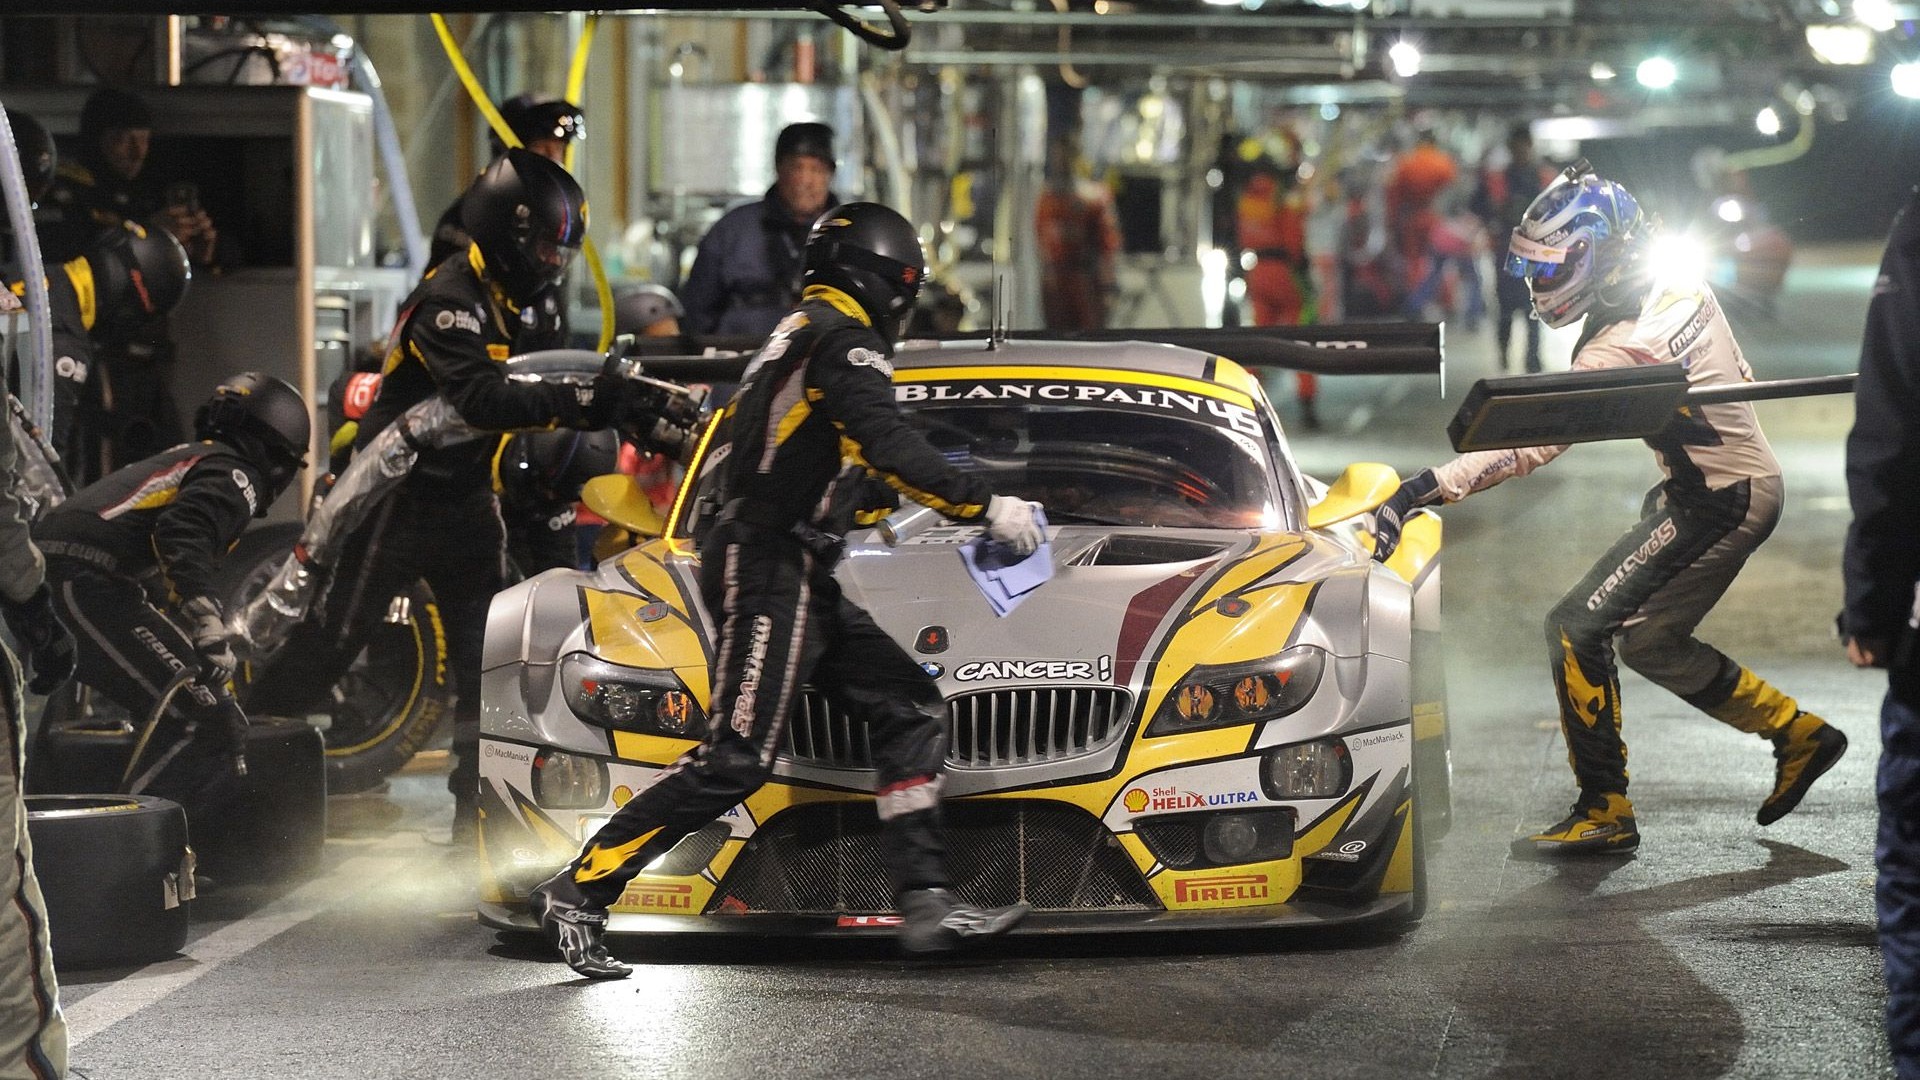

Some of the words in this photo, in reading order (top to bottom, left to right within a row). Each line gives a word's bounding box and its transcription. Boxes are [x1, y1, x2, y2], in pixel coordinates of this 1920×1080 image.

[892, 384, 1203, 414] BLANCPAIN
[1205, 399, 1264, 438] 45
[1152, 786, 1176, 797] Shell
[1152, 794, 1208, 811] HELIX
[1208, 790, 1259, 806] ULTRA
[1174, 874, 1268, 903] PIRELLI
